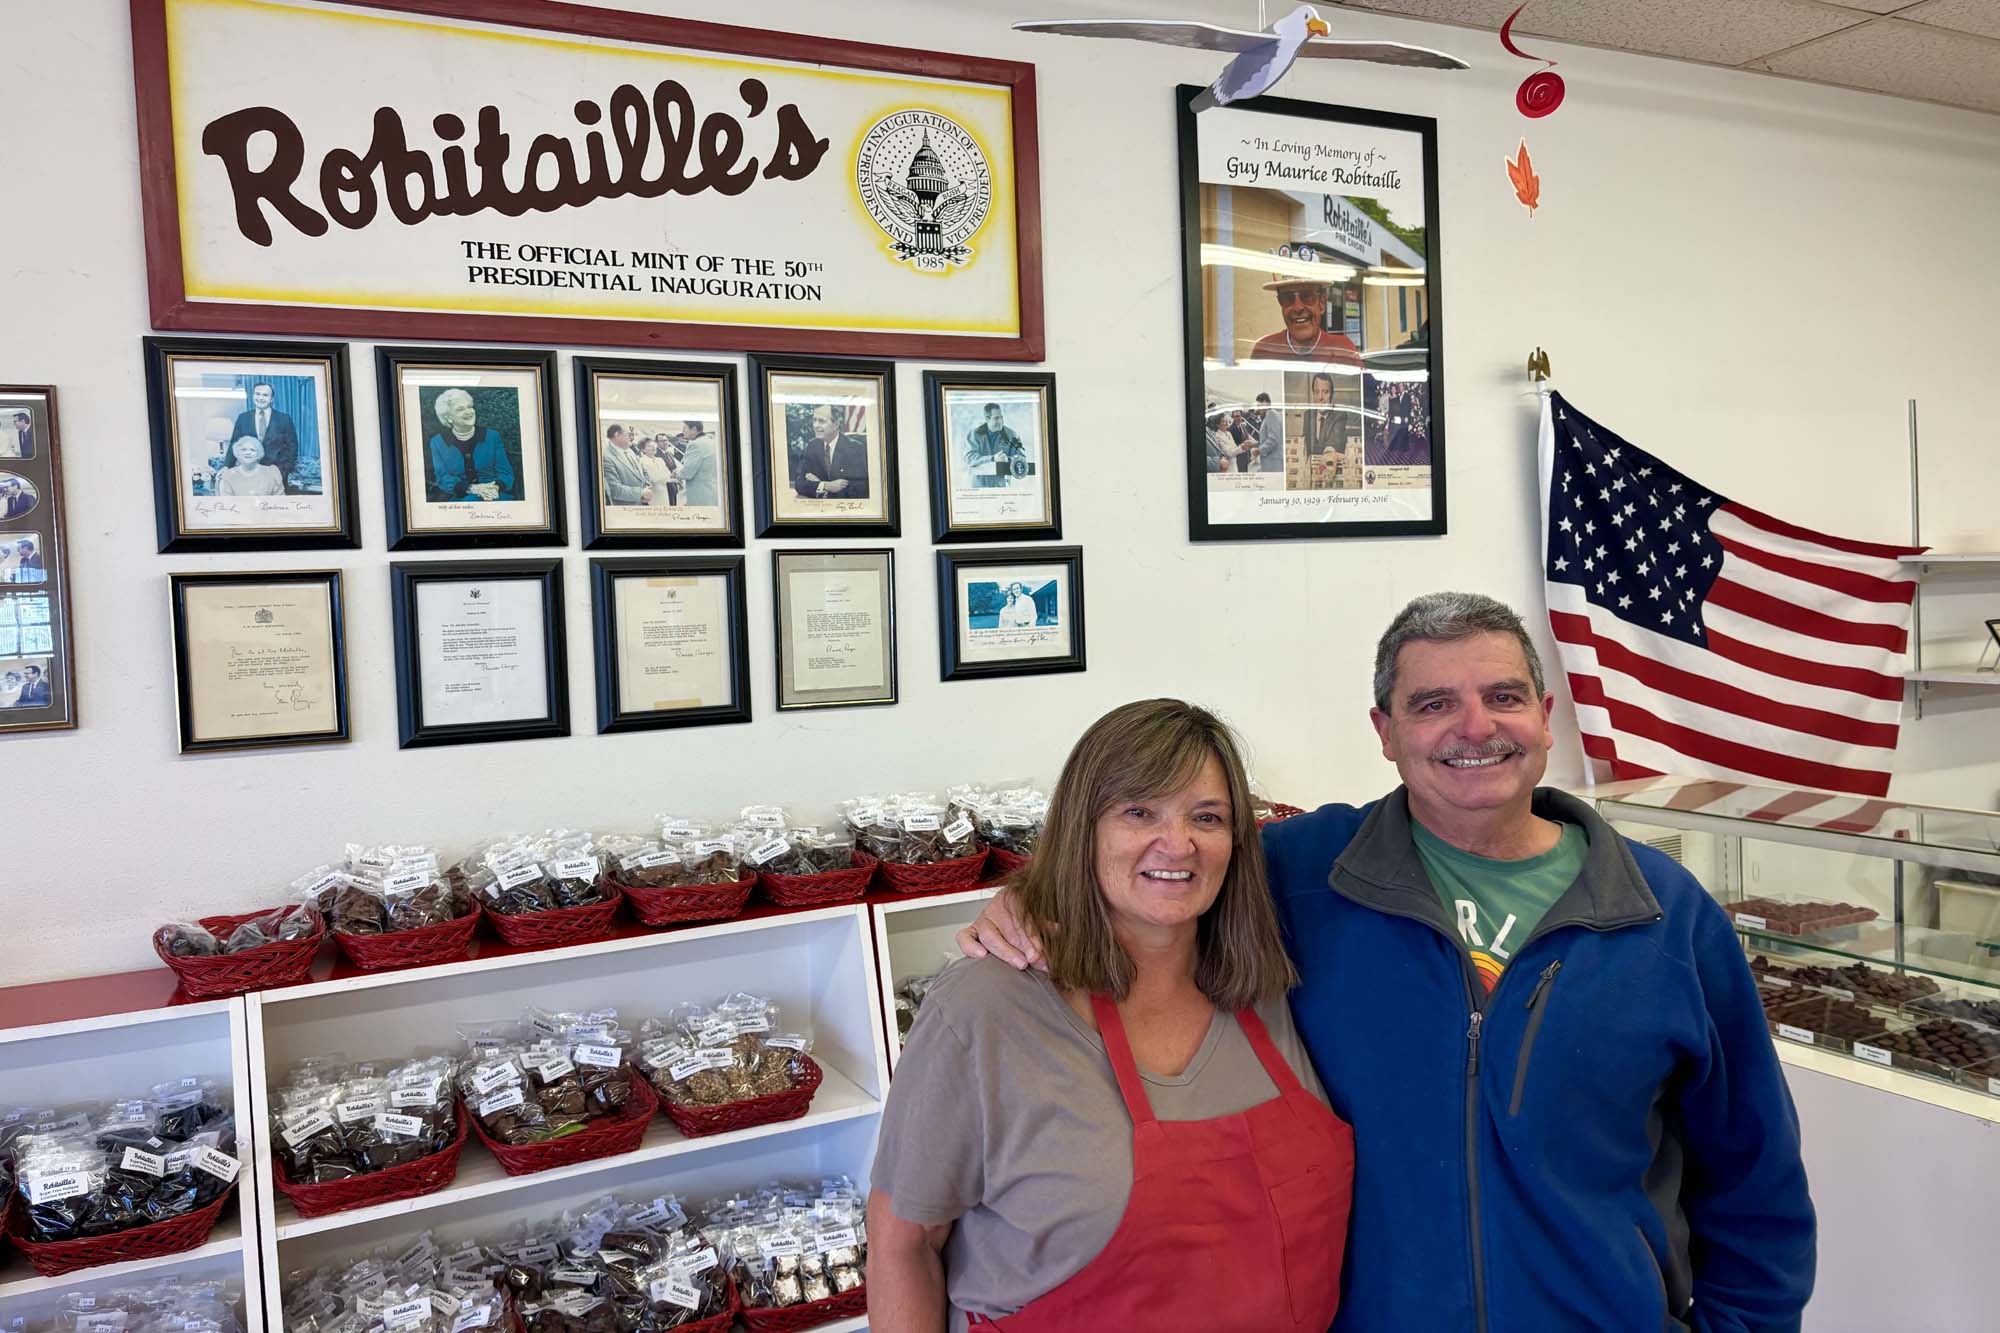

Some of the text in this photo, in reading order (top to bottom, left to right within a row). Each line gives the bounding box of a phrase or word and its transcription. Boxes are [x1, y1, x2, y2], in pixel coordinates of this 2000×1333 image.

[868, 113, 975, 151] INAUGURATION OF
[1254, 138, 1376, 168] In Loving Memory of
[202, 78, 830, 247] Robitaille's
[1226, 157, 1401, 190] Guy Maurice Robitaille
[888, 178, 961, 200] REAGAN BUSH
[860, 153, 990, 245] PRESIDENT AND VICE PRESIDENT
[461, 240, 511, 261] THE
[518, 244, 625, 268] OFFICIAL
[631, 251, 689, 271] MINT
[695, 255, 725, 273] OF
[731, 258, 775, 277] THE
[916, 256, 945, 269] 1985
[467, 265, 822, 301] PRESIDENTIAL INAUGURATION
[1258, 496, 1289, 507] January
[1304, 496, 1321, 506] 1929
[1327, 494, 1359, 507] February
[1372, 495, 1388, 503] 2016
[393, 875, 420, 885] Robitaille's
[482, 1069, 507, 1082] Robitaille's
[487, 1092, 513, 1106] Robitaille's
[346, 1103, 374, 1112] Robitaille's
[291, 1118, 319, 1134] Robitaille's
[385, 1117, 413, 1126] Robitaille's
[134, 1152, 156, 1164] Robitaille's
[207, 1152, 231, 1168] Robitaille's
[43, 1178, 76, 1190] Robitaille's
[392, 1304, 421, 1316] Robitaille's
